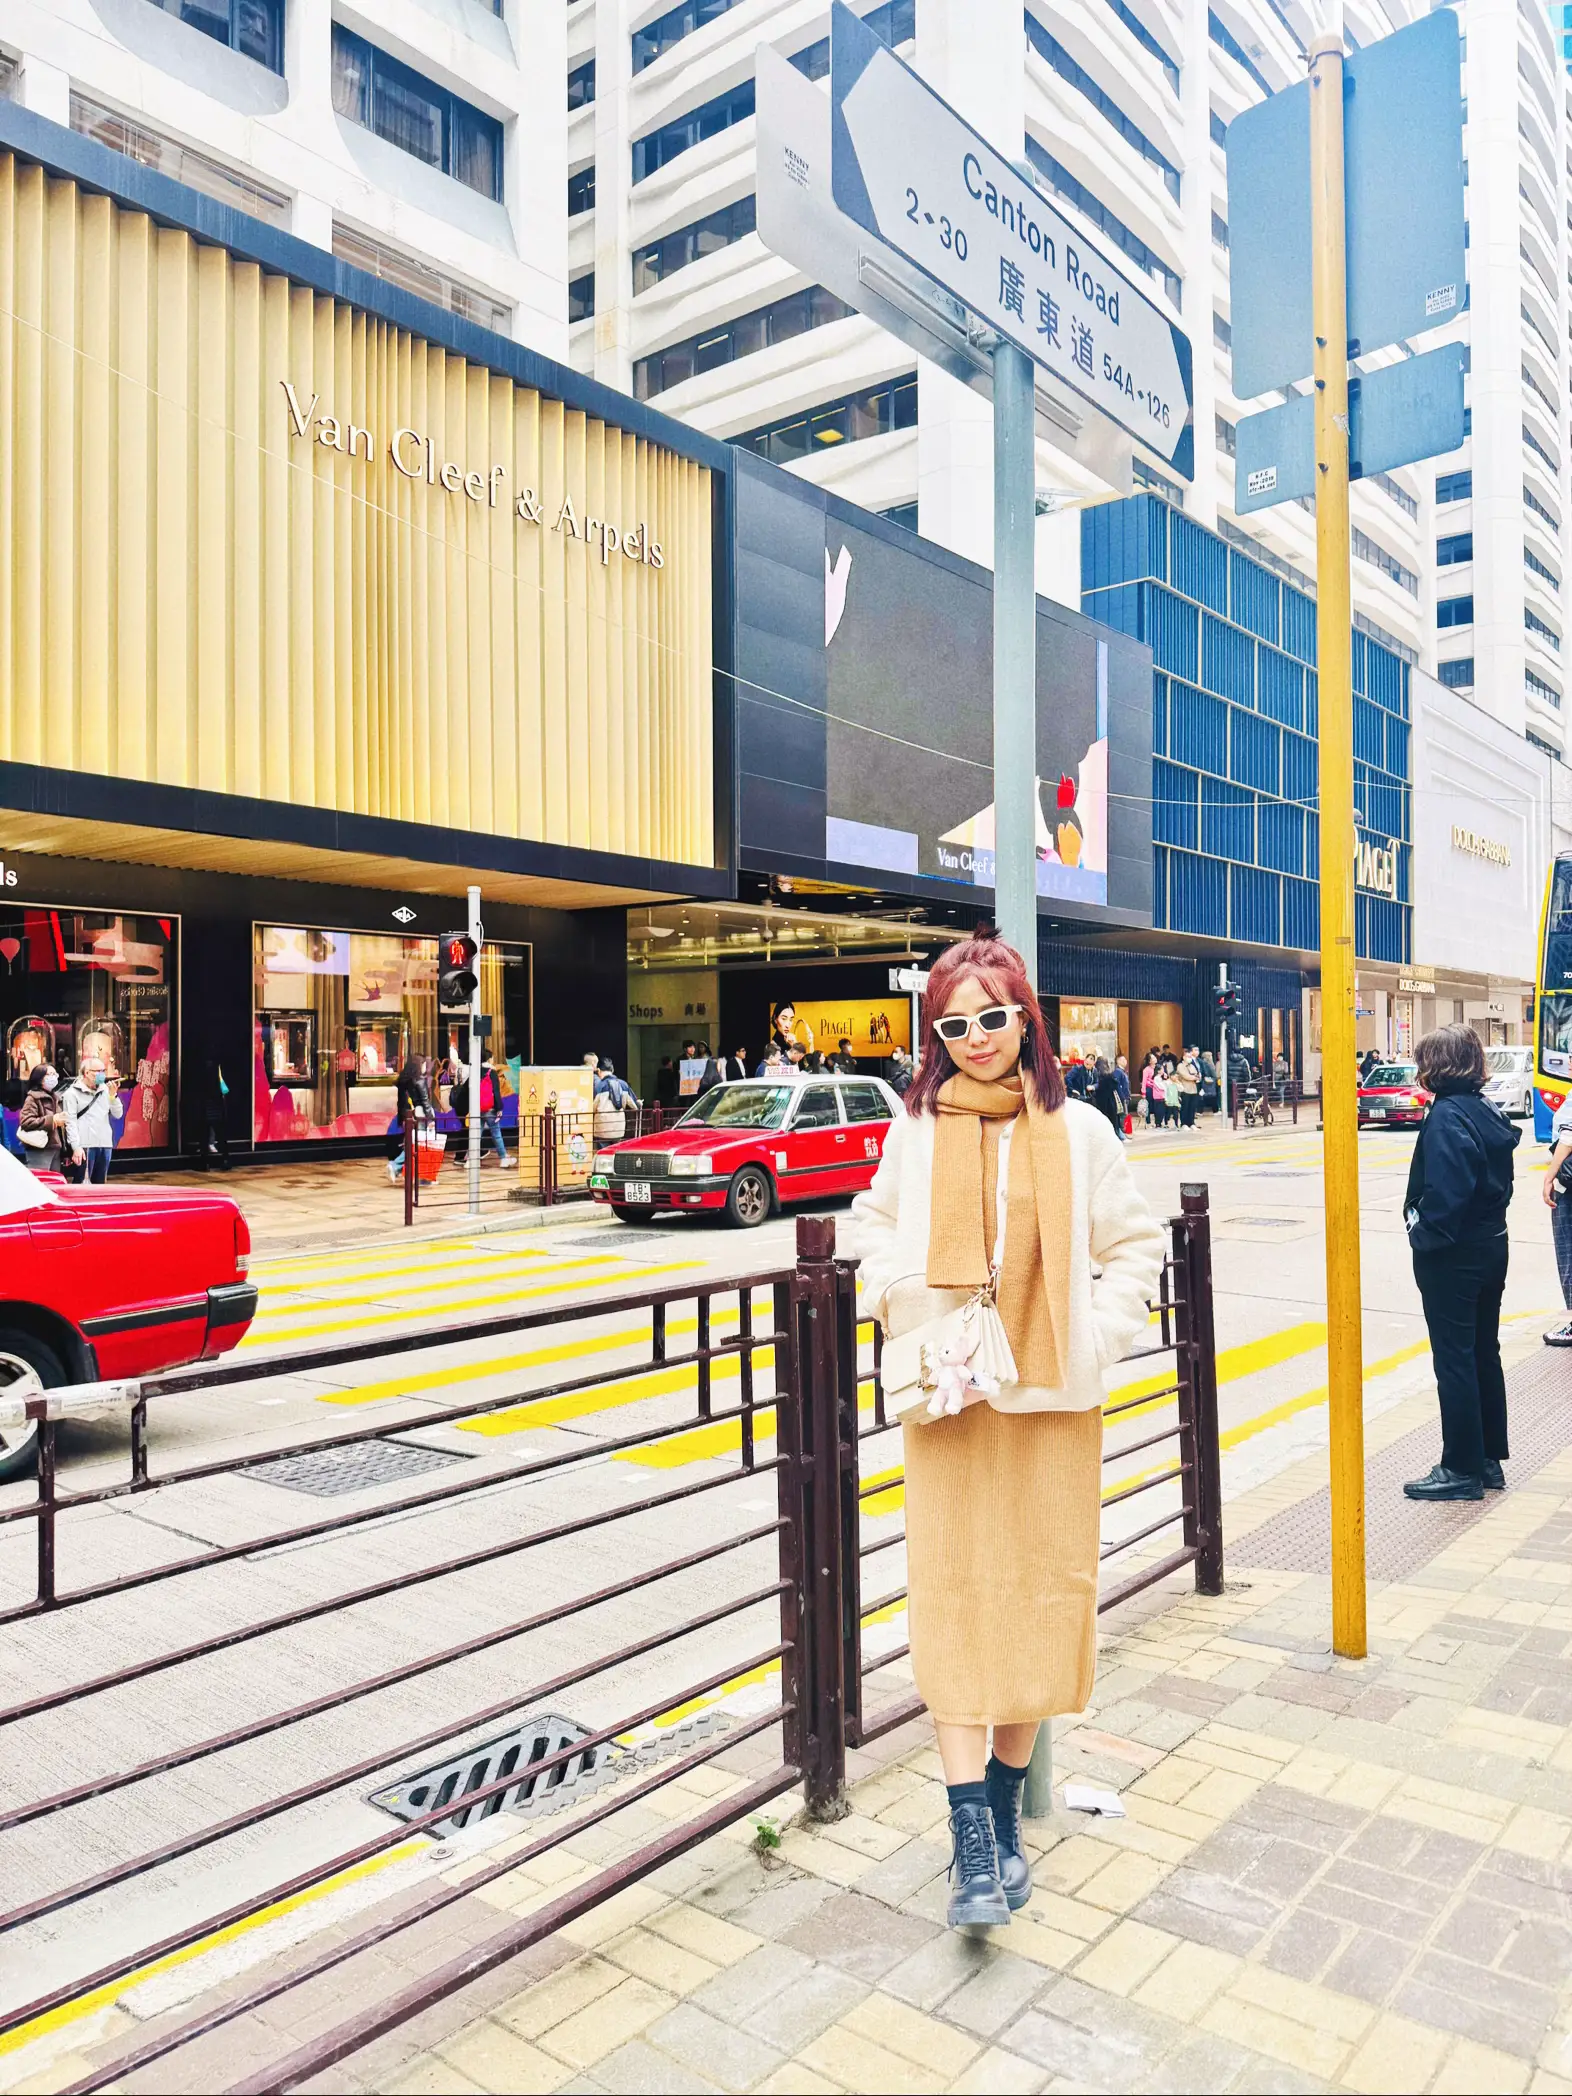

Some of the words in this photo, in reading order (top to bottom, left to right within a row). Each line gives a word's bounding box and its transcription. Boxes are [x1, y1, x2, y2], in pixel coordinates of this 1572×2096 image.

[785, 146, 809, 171] KENNY
[963, 152, 1056, 269] Canton
[1067, 244, 1120, 326] Road
[1427, 285, 1455, 300] KENNY
[999, 255, 1096, 380] 廣東道
[280, 381, 374, 463] Van
[390, 428, 508, 508] Cleef
[516, 486, 544, 526] &
[555, 494, 665, 570] Arpels
[937, 847, 958, 869] Van
[960, 851, 988, 875] Cleef
[629, 1003, 664, 1020] Shops
[820, 1017, 854, 1037] PIAGET
